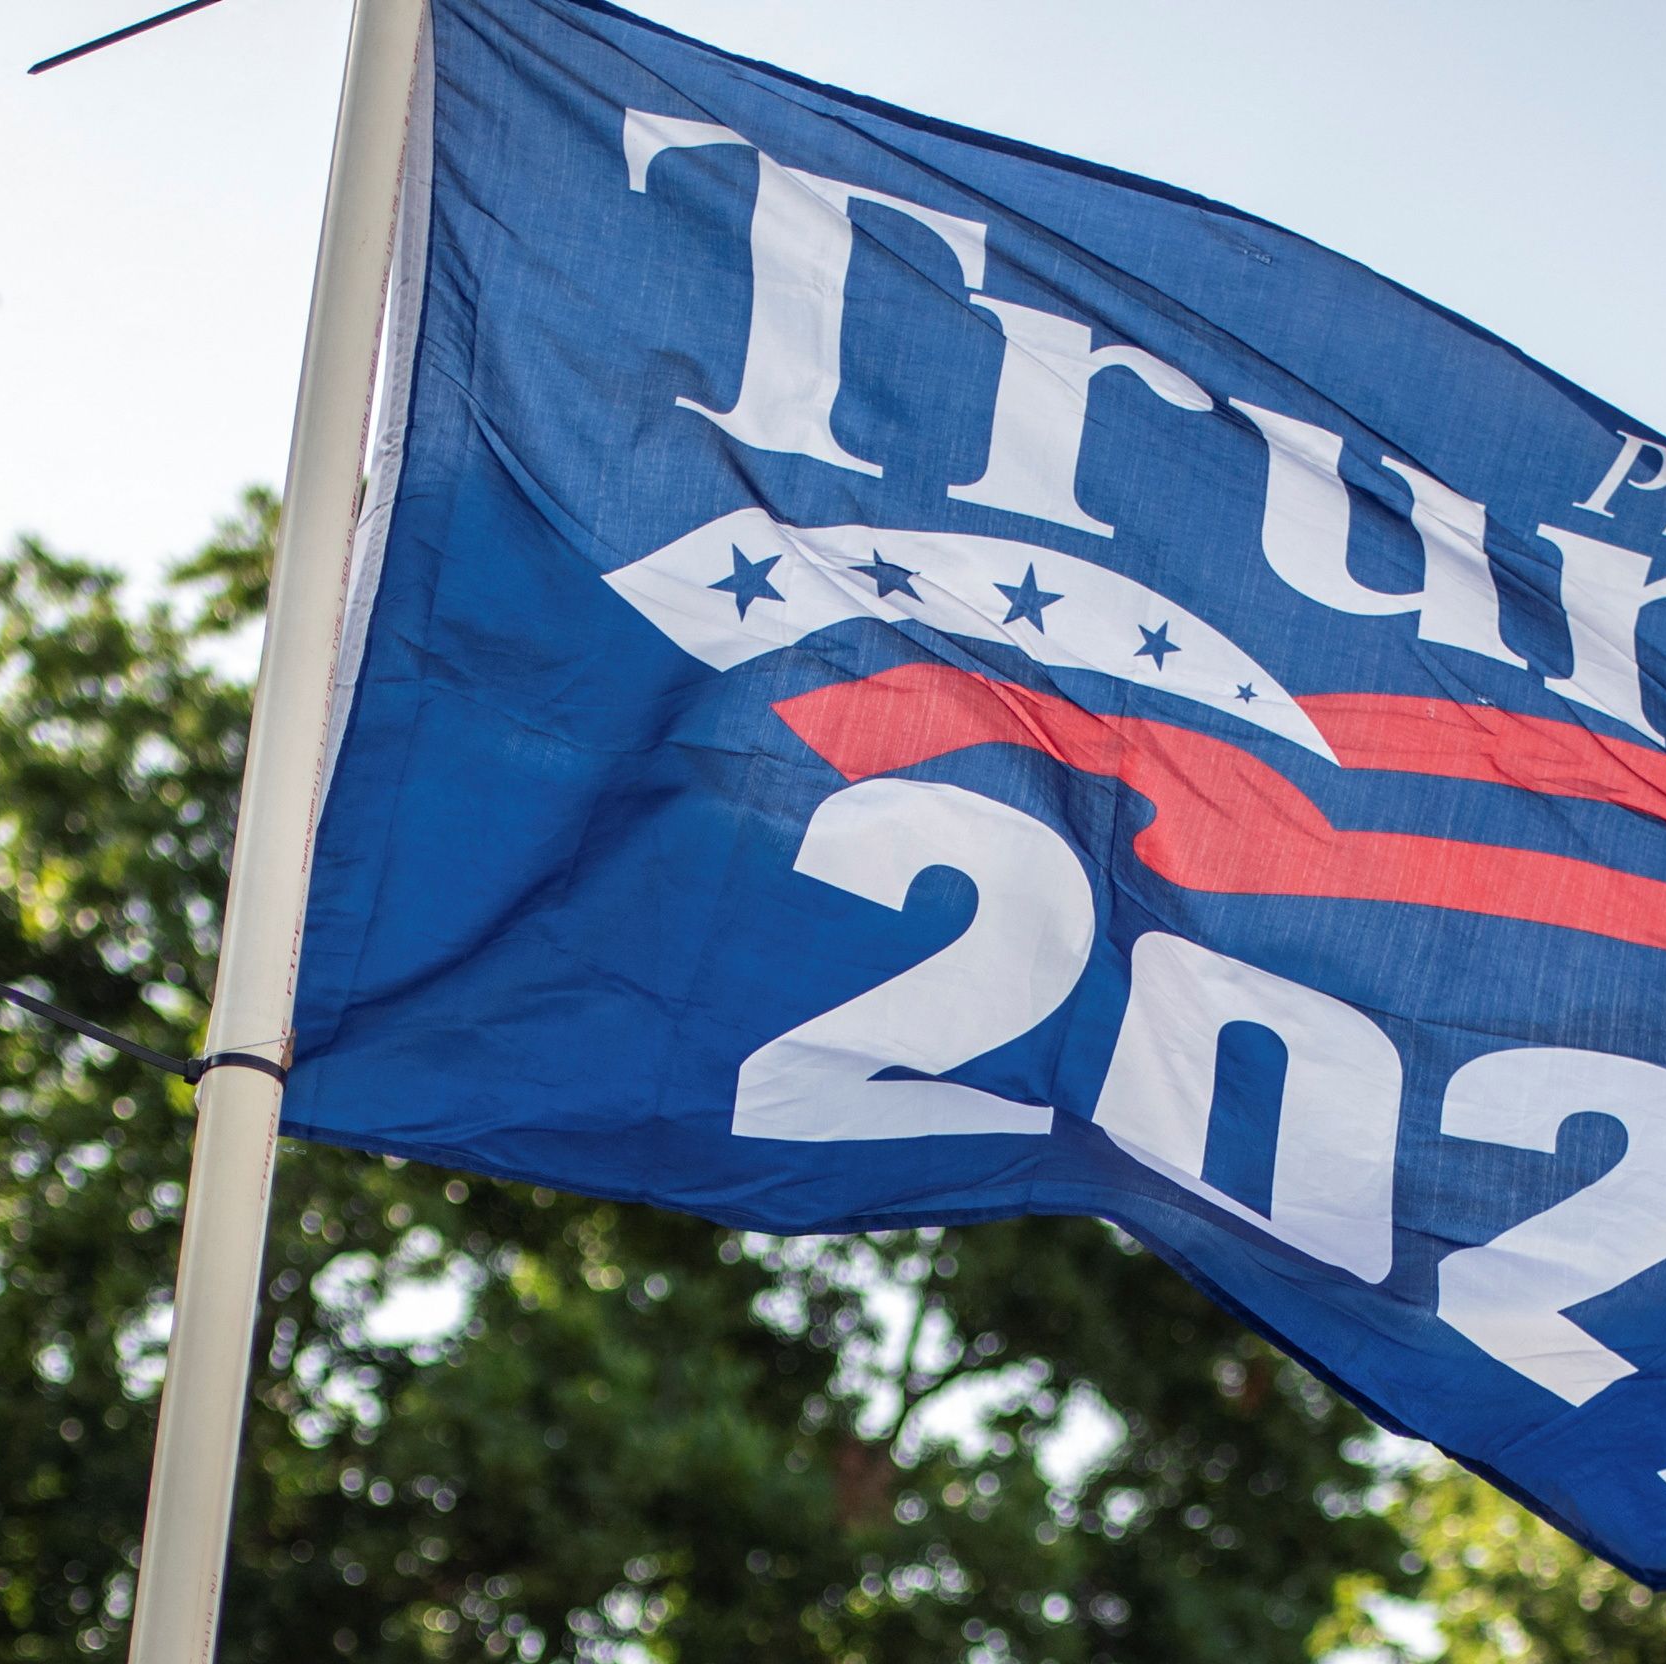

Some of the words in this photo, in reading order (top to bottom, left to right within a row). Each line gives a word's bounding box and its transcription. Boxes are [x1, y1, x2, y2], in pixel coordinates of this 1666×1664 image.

[333, 613, 342, 650] TYPE
[347, 527, 353, 547] 40
[261, 1015, 288, 1201] CHARLOTE
[287, 916, 301, 995] PIPE
